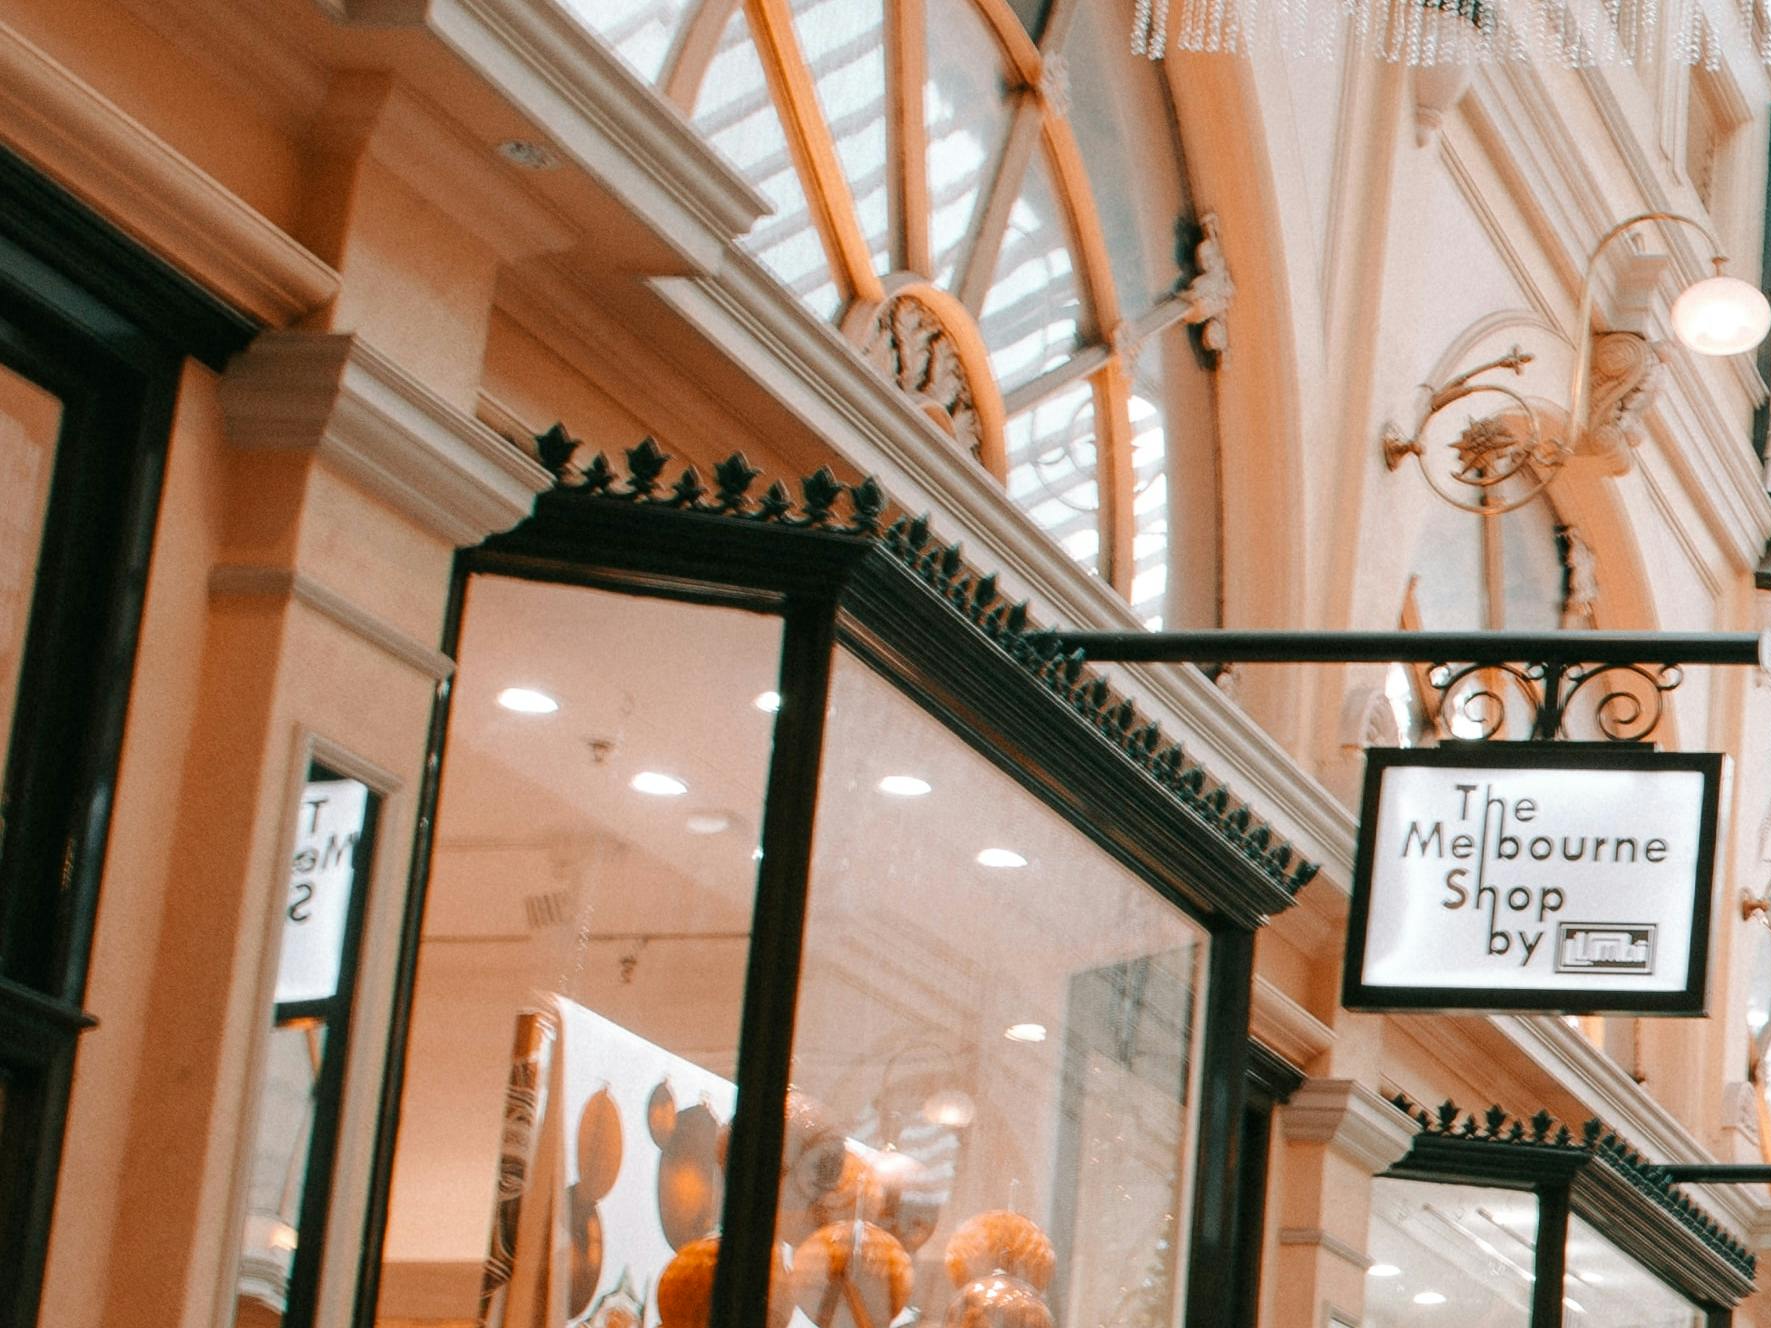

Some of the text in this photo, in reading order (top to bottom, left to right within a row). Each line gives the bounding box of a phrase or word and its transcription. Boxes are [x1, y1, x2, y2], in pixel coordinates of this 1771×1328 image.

[1455, 784, 1537, 823] The
[1402, 819, 1670, 865] Melbourne
[1441, 868, 1567, 923] Shop
[1488, 929, 1544, 967] by
